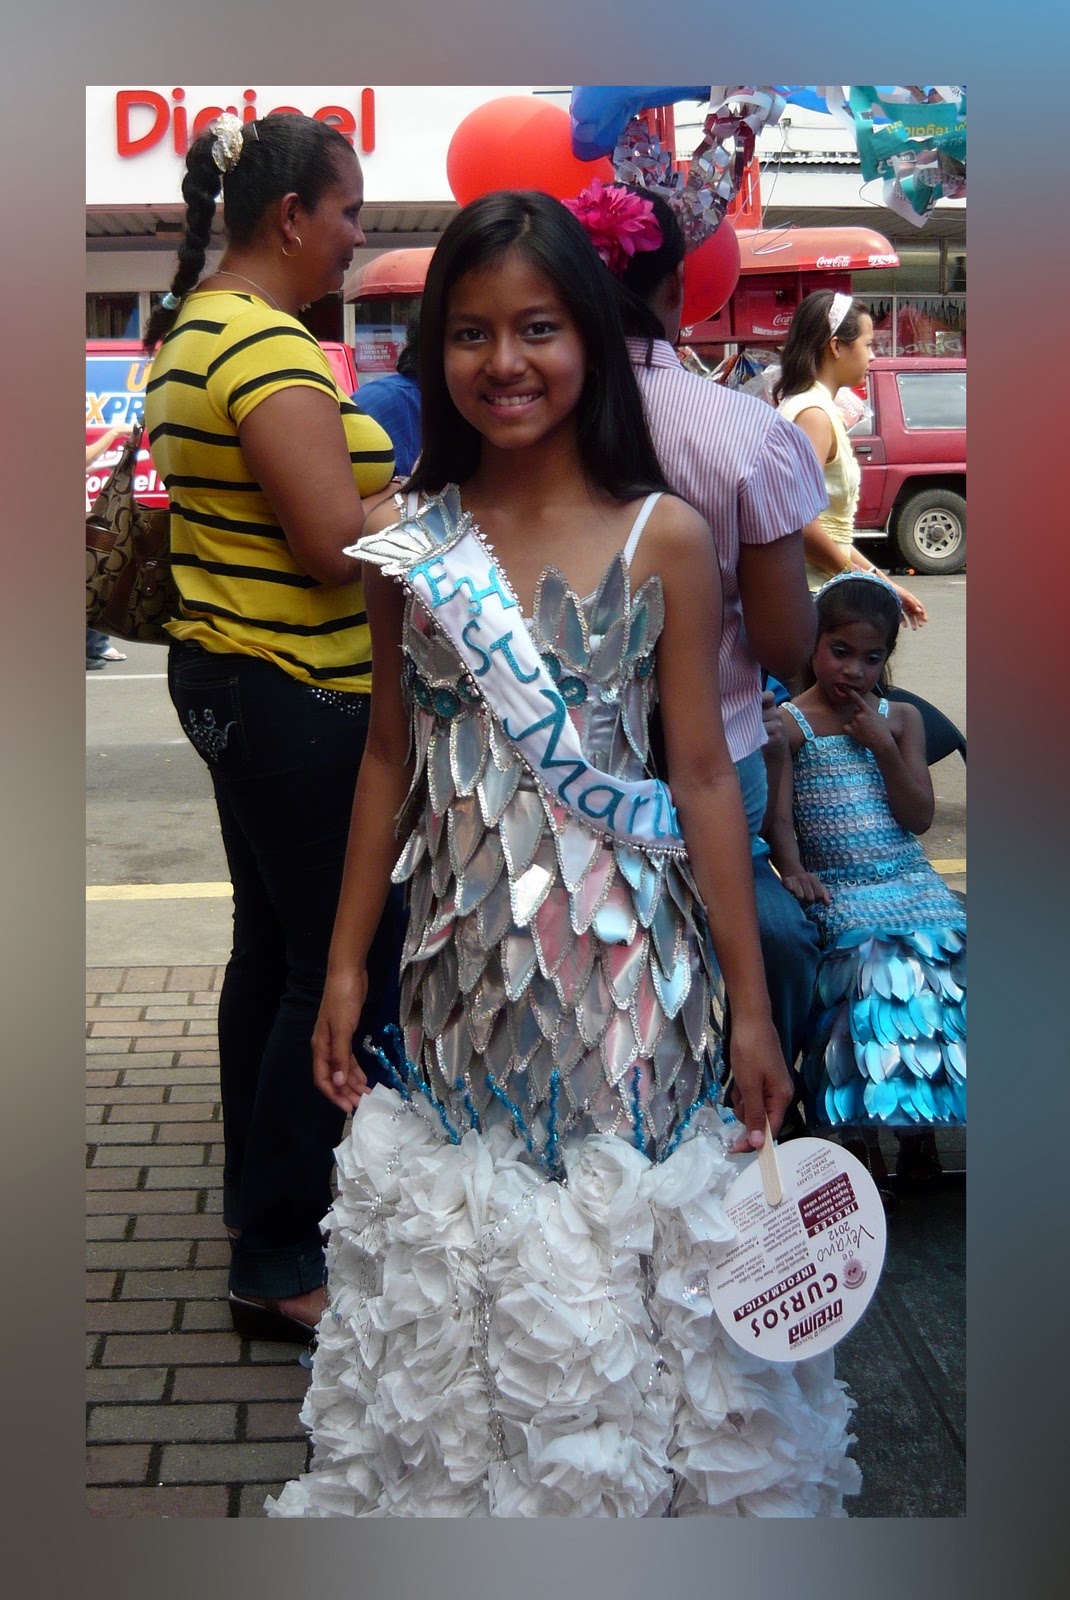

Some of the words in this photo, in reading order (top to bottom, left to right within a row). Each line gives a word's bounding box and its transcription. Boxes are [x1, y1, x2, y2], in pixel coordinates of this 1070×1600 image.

[817, 1224, 874, 1262] Verano
[827, 1221, 850, 1240] 2012
[840, 1249, 855, 1262] de
[748, 1270, 839, 1338] CURSOS
